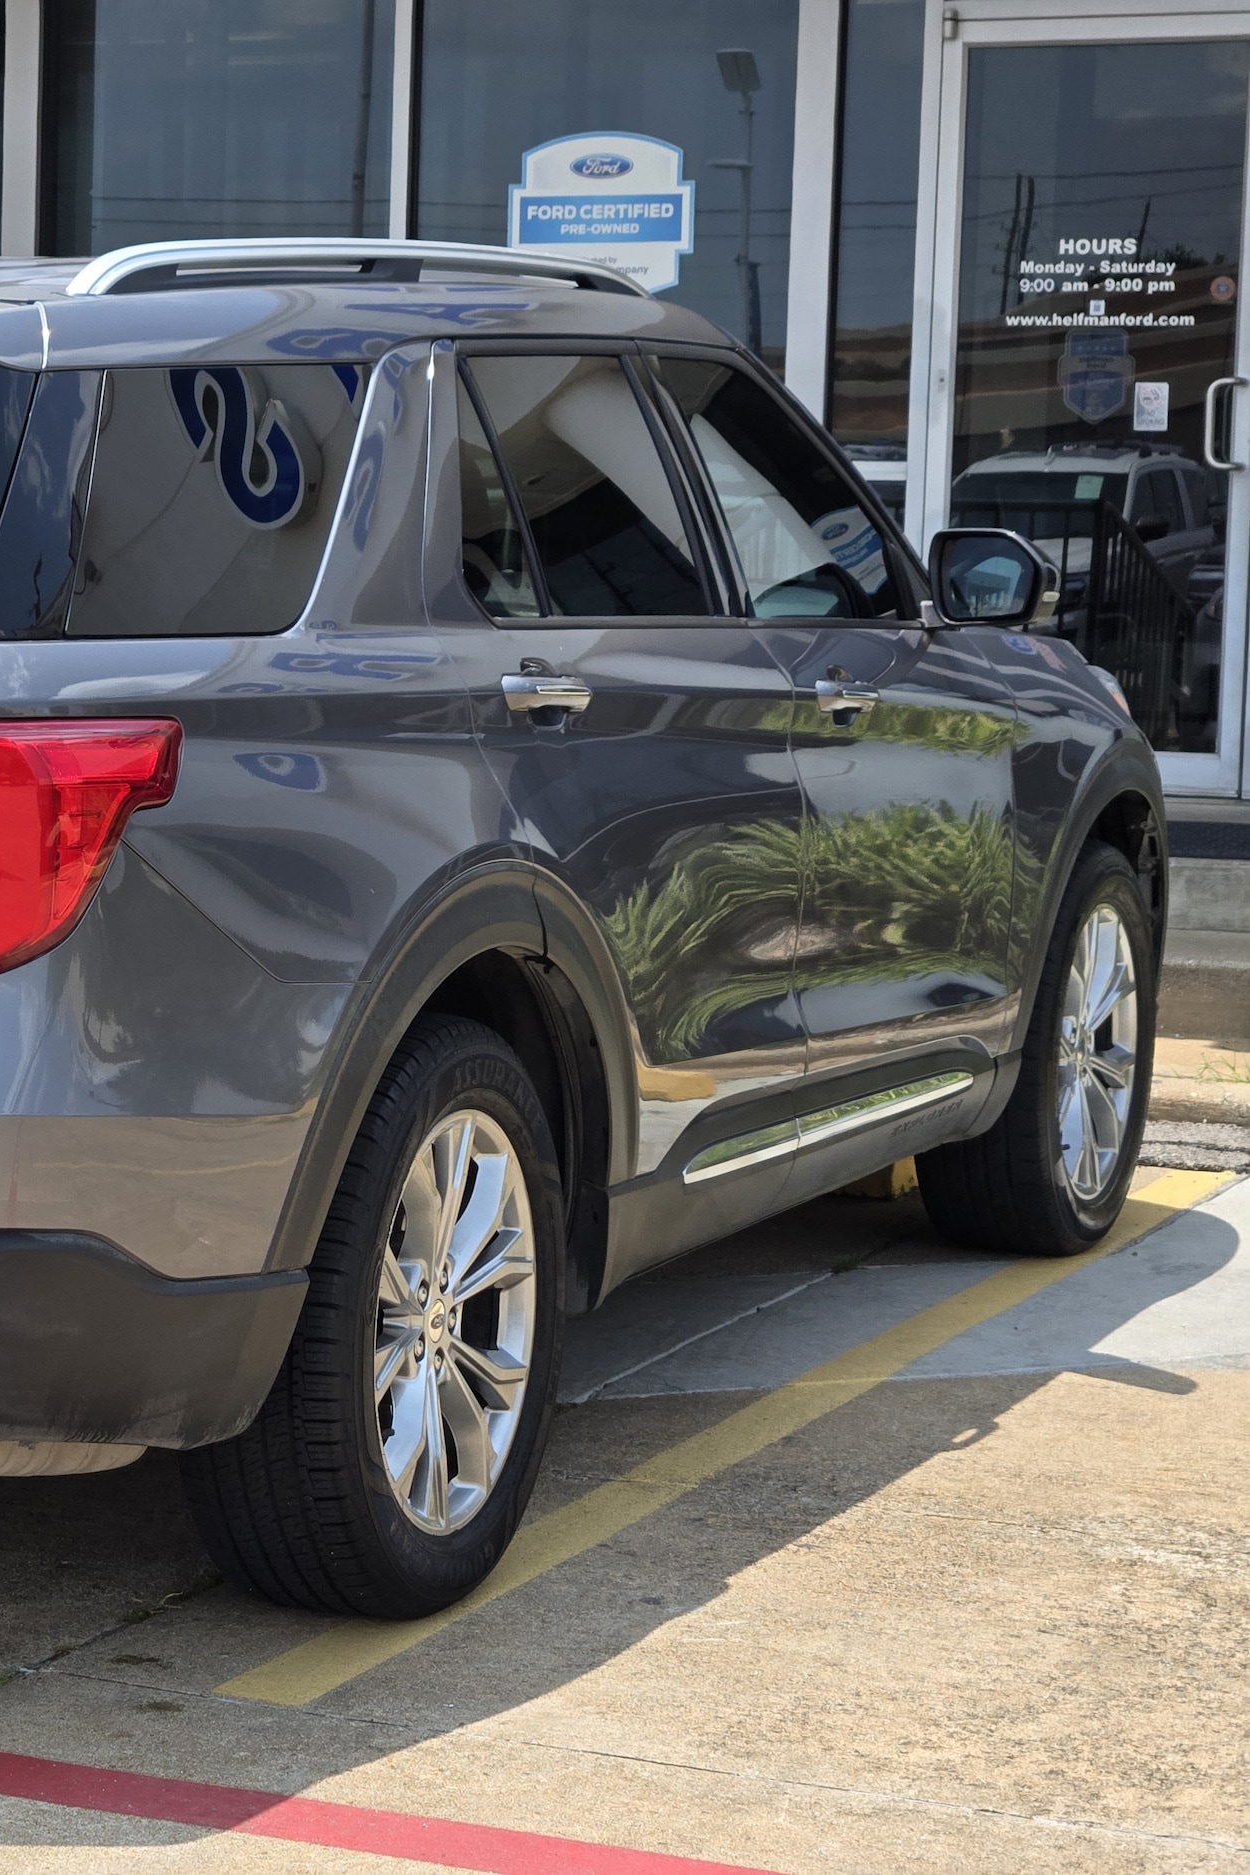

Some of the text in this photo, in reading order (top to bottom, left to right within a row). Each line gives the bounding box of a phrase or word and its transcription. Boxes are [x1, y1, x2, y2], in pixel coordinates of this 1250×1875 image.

[582, 157, 620, 175] Ford
[527, 203, 674, 220] FORD CERTIFIED
[560, 223, 640, 235] PRE-OWNED
[1059, 238, 1138, 255] HOURS
[613, 266, 649, 276] mpany
[1020, 261, 1085, 277] Monday
[1100, 260, 1176, 276] Saturday
[1020, 278, 1055, 292] 9:00
[1061, 281, 1089, 292] am
[1104, 278, 1143, 292] 9:00
[1147, 281, 1176, 295] pm
[1006, 313, 1195, 327] www.helfmanford.com
